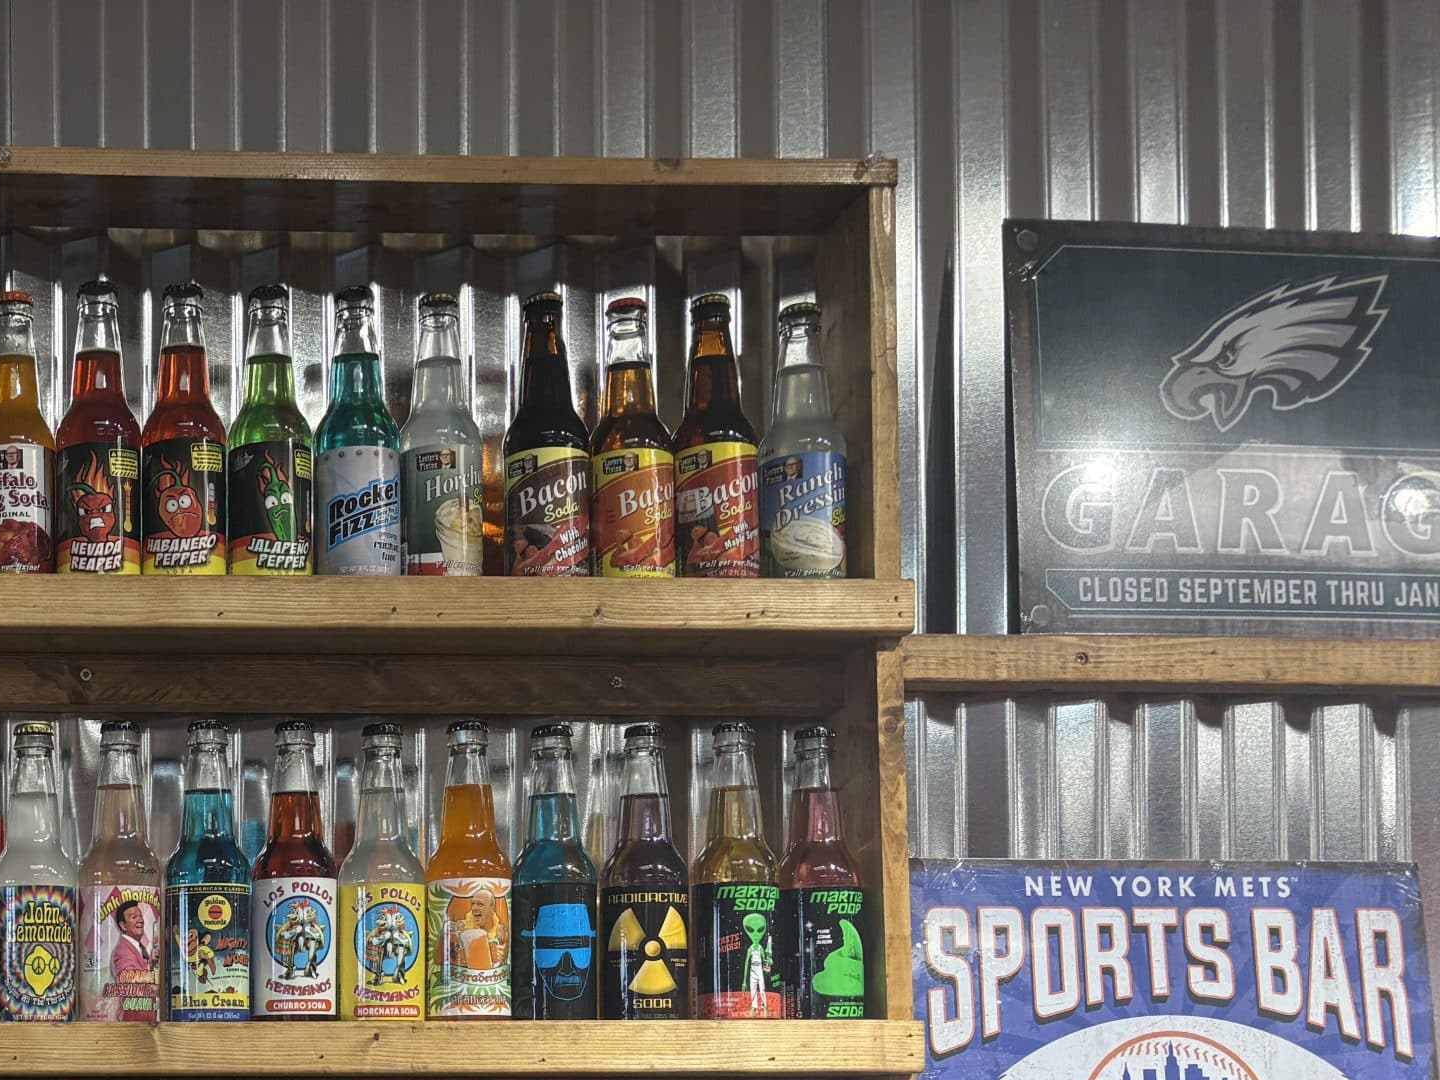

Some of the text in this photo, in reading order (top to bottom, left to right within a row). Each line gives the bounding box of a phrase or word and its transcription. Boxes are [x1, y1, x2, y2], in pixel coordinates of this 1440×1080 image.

[518, 468, 587, 517] Bacon
[71, 540, 122, 556] NEVADA
[147, 535, 216, 552] HABANERO
[247, 535, 308, 554] JALAPEÑO
[71, 554, 122, 571] REAPER
[155, 552, 209, 566] PEPPER
[257, 552, 306, 569] PEPPER
[1078, 576, 1384, 606] CLOSED SEPTEMBER THRU
[264, 882, 333, 906] LOS POLLOS
[1025, 876, 1292, 898] NEW YORK METS
[609, 893, 688, 905] RADIOACTIVE
[25, 901, 61, 924] John
[266, 978, 331, 996] HERMANOS
[925, 905, 1415, 1058] SPORTS BAR
[308, 1001, 327, 1009] SODA
[357, 1007, 417, 1016] HORCHATA SODA
[633, 999, 672, 1009] SODA
